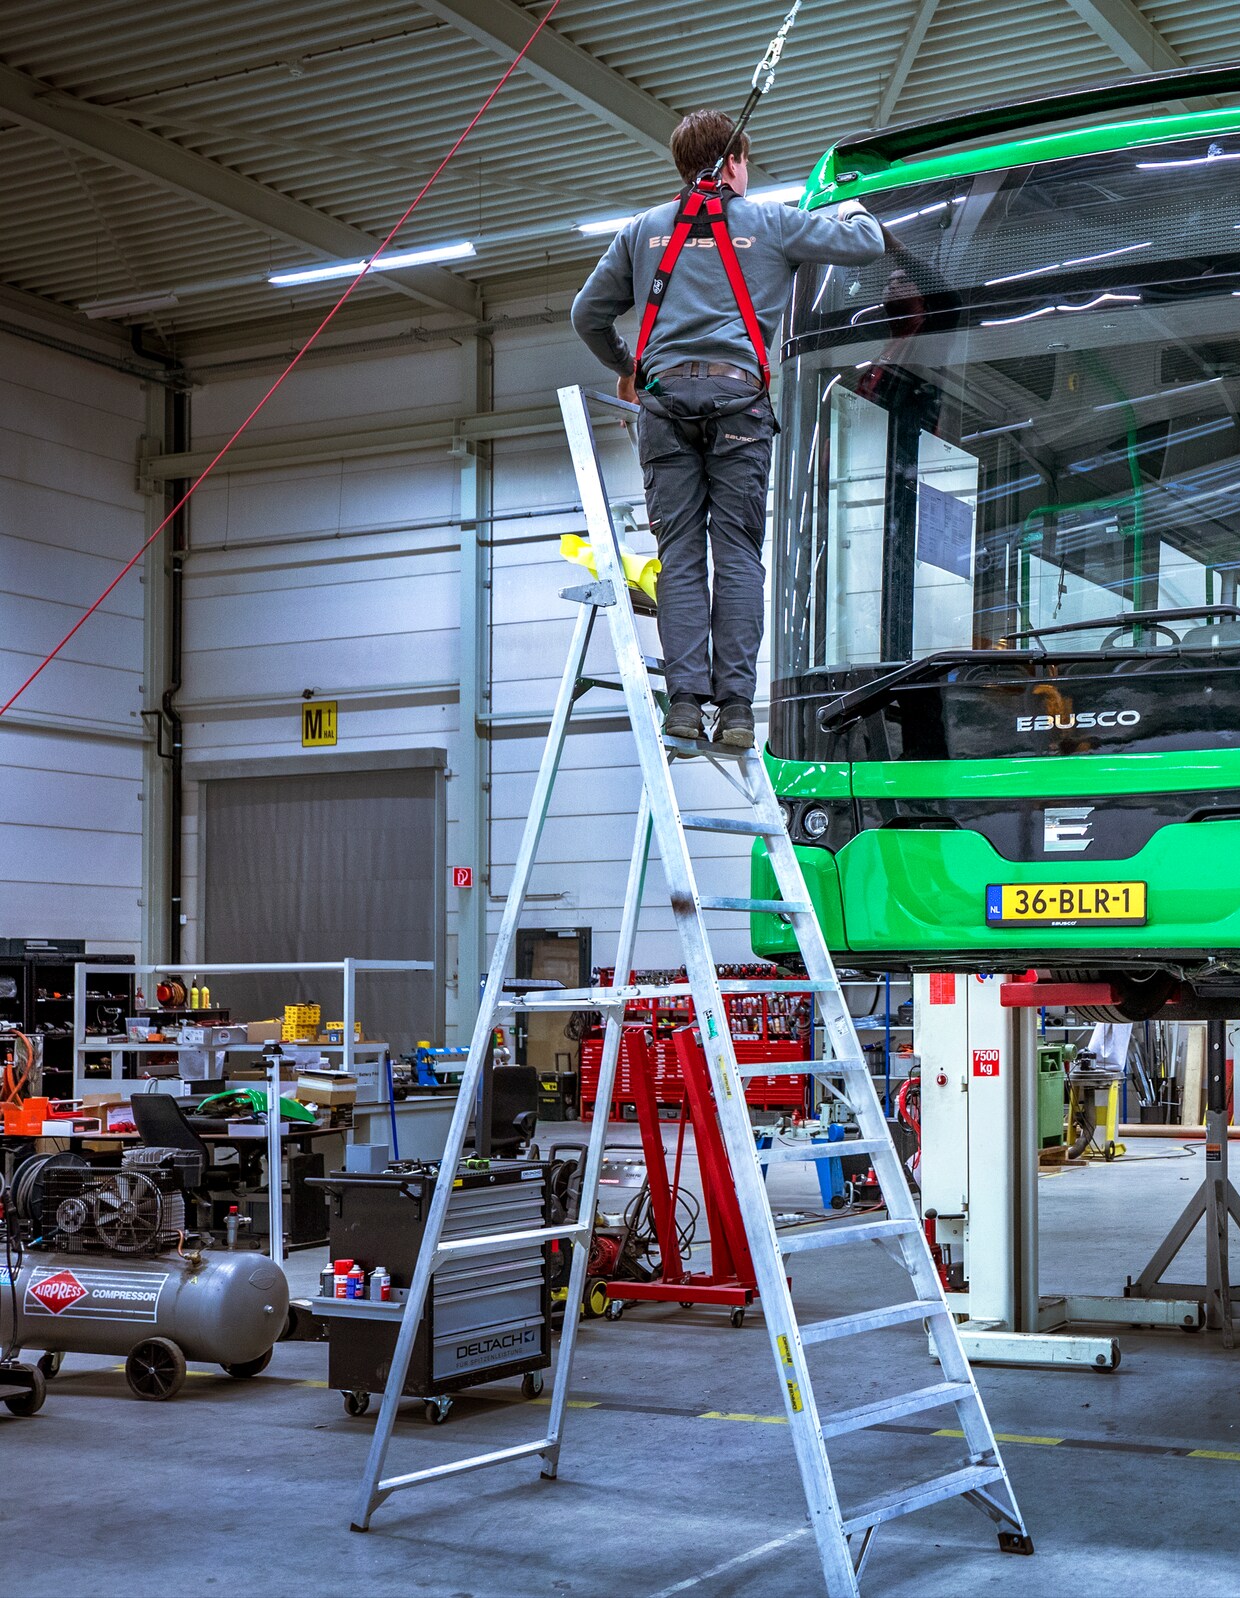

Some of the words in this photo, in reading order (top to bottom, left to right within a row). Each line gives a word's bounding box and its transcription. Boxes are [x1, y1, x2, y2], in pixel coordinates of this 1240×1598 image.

[305, 709, 322, 739] M
[1017, 710, 1141, 732] EBUSCO
[323, 730, 334, 738] HAL
[1044, 807, 1095, 852] E
[1015, 888, 1129, 914] 36-BLR-1
[990, 906, 1000, 914] NL
[974, 1051, 999, 1061] 7500
[980, 1062, 993, 1075] kg
[35, 1283, 82, 1299] AIRPRESS
[92, 1289, 157, 1301] COMPRESSOR
[457, 1332, 522, 1359] DELTACH
